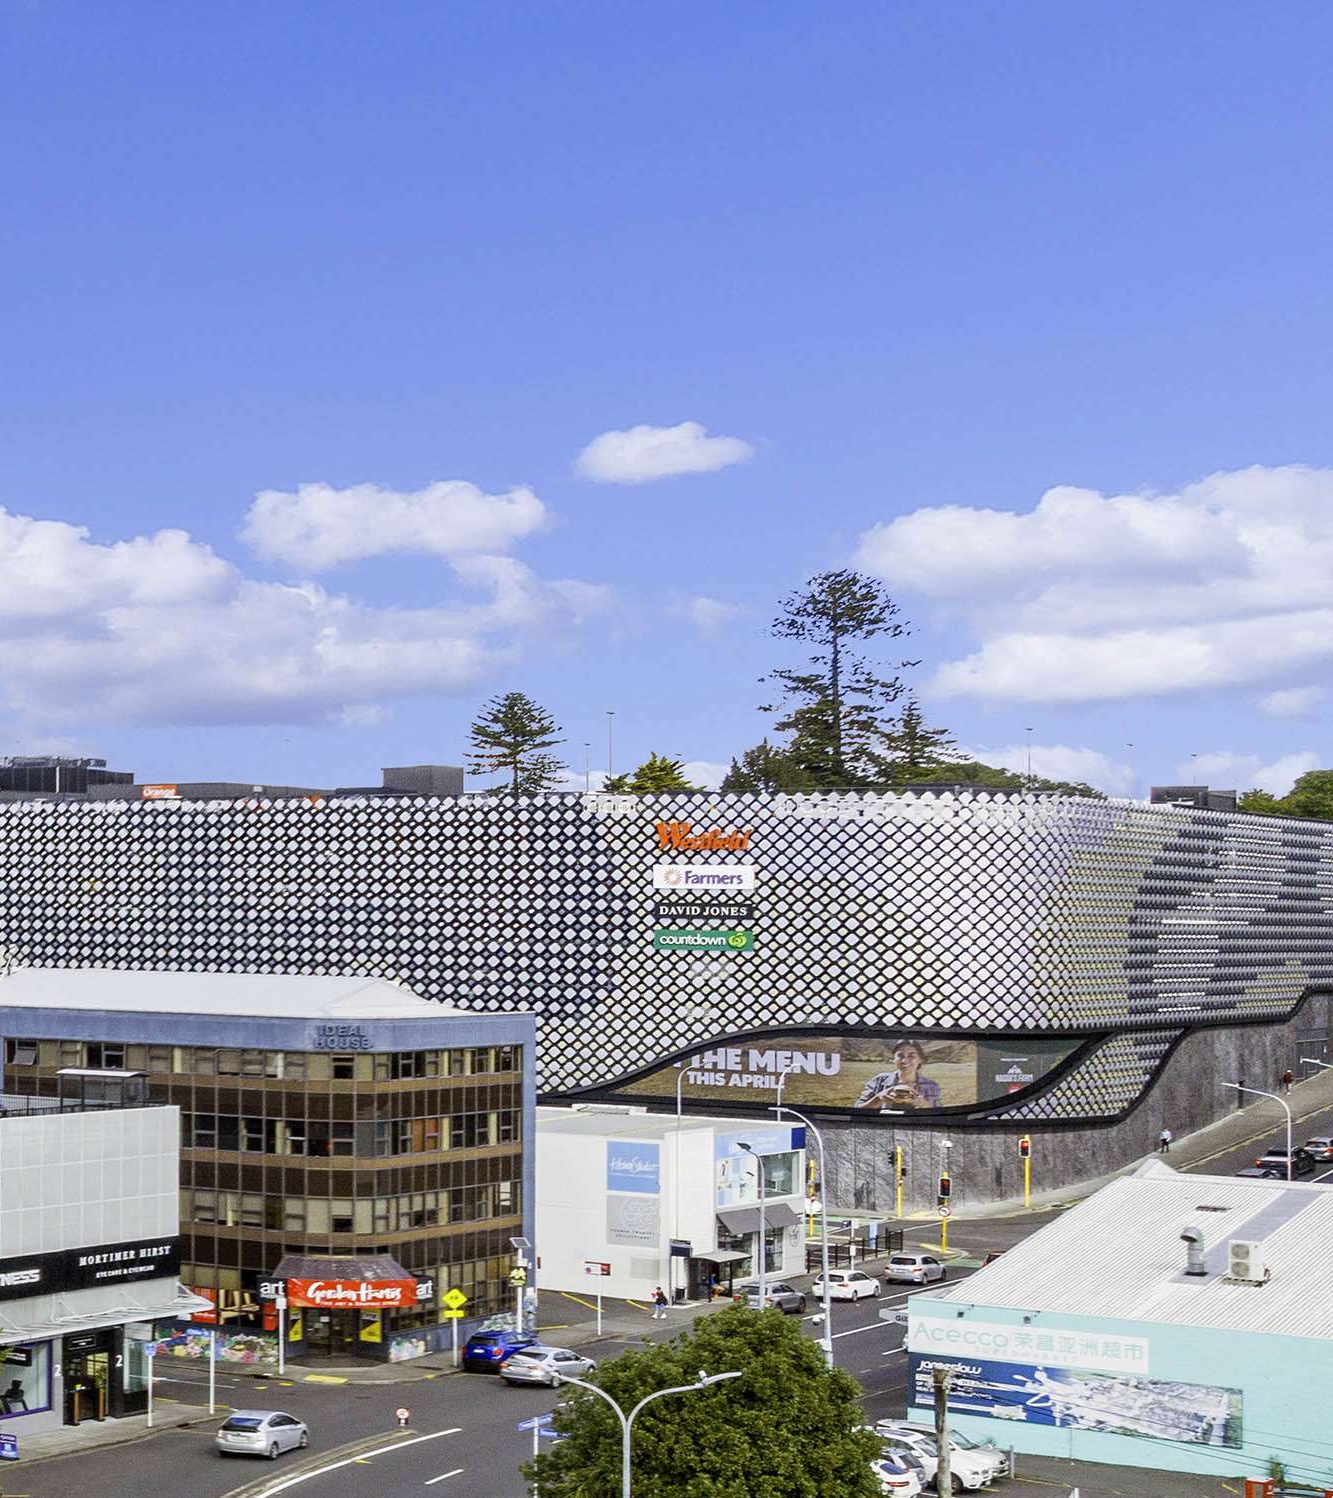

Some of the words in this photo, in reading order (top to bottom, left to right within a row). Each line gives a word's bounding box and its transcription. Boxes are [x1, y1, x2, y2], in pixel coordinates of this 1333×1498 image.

[655, 821, 753, 851] Westfield
[684, 870, 743, 885] Farmers
[659, 905, 700, 916] DAVID
[703, 905, 747, 916] JONES
[660, 934, 726, 946] countdown
[317, 1024, 366, 1037] IDEAL
[314, 1038, 373, 1050] HOUSE
[749, 1049, 841, 1076] MENU
[686, 1071, 726, 1086] THIS
[79, 1249, 136, 1267] MORTIMER
[139, 1245, 172, 1258] HIRST
[260, 1280, 286, 1296] art
[416, 1279, 434, 1296] art
[912, 1320, 1010, 1348] Acecco
[115, 1354, 123, 1367] 2
[53, 1364, 62, 1377] 2
